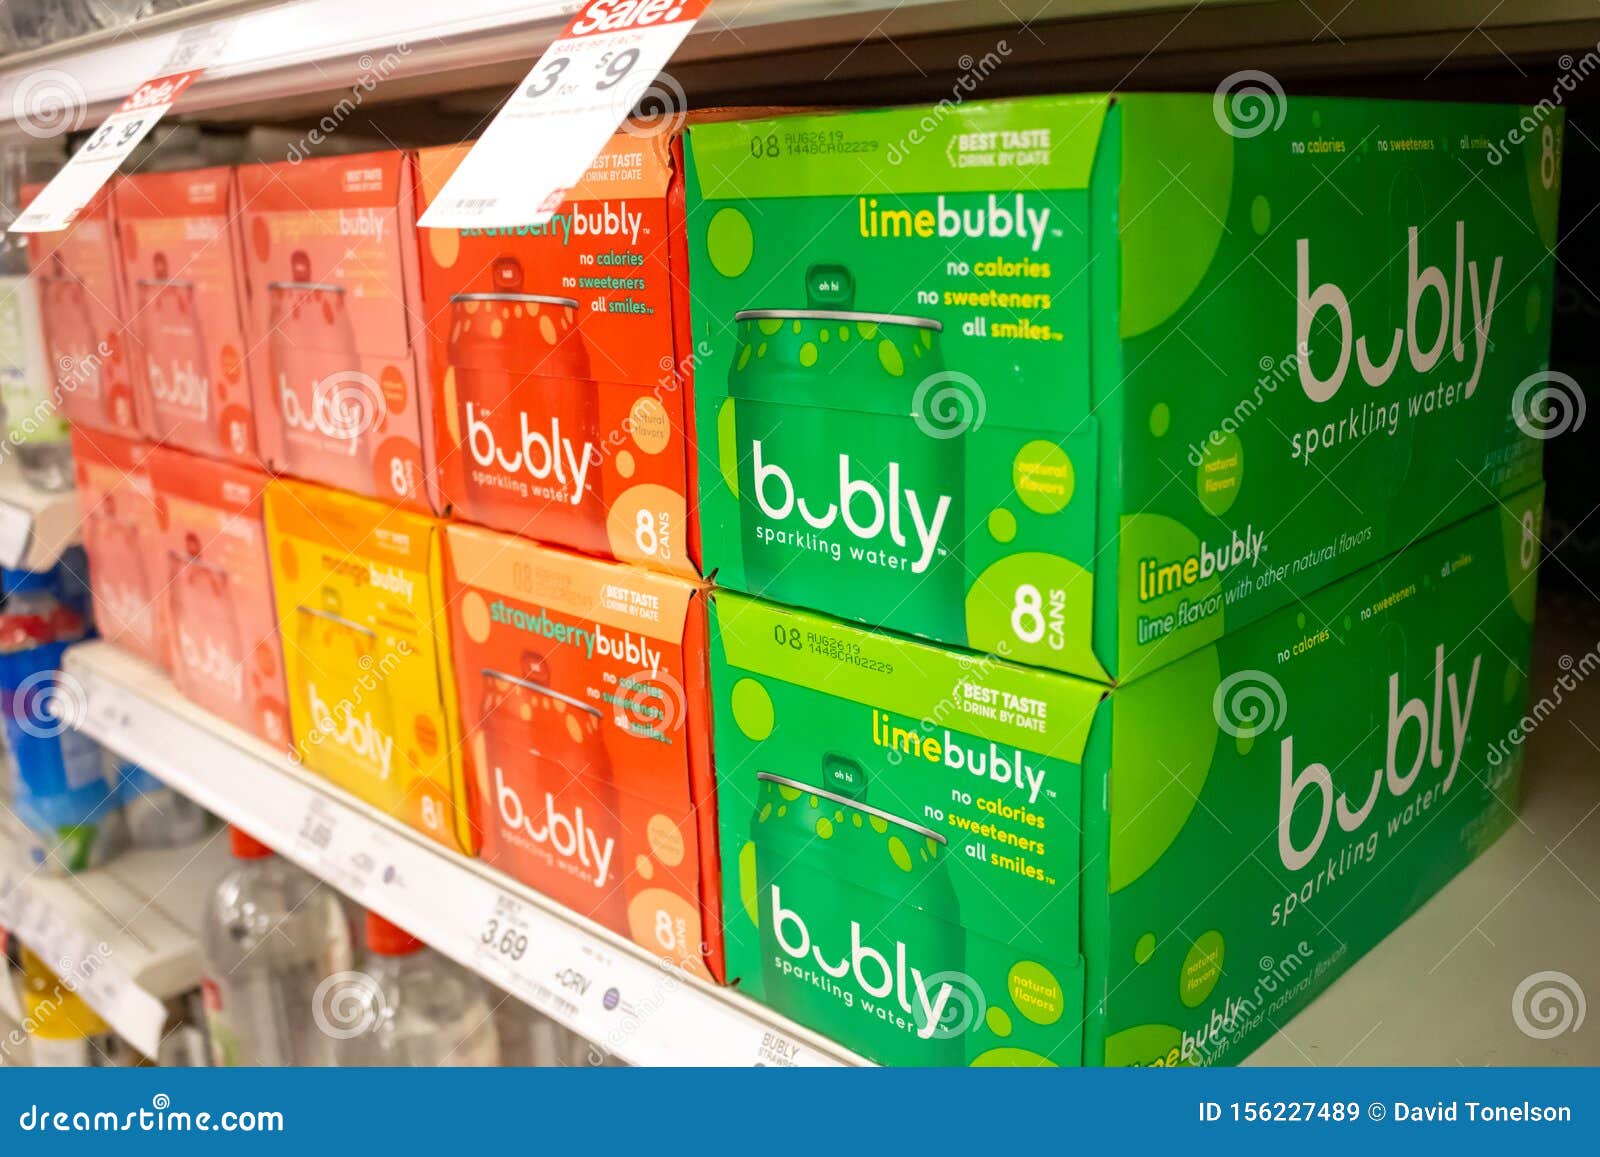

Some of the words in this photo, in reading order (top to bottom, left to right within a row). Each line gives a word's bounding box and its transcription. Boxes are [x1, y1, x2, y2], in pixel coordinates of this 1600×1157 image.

[572, 0, 687, 34] Sale!
[526, 57, 571, 98] 3
[751, 135, 780, 159] 08
[959, 132, 997, 150] BEST
[1002, 129, 1050, 150] TASTE
[1291, 140, 1305, 154] no
[1307, 136, 1345, 153] calories
[1377, 139, 1388, 152] no
[1390, 138, 1434, 151] sweeteners
[612, 152, 642, 168] TASTE
[621, 168, 642, 181] DATE
[958, 154, 995, 168] DRINK
[998, 153, 1013, 167] BY
[1016, 151, 1050, 166] DATE
[859, 194, 1050, 251] limebubly
[580, 253, 594, 265] no
[596, 251, 644, 266] calories
[946, 261, 970, 276] no
[973, 256, 1051, 278] calories
[562, 277, 576, 288] no
[579, 276, 645, 290] sweeteners
[819, 280, 830, 291] oh
[831, 280, 839, 291] hi
[591, 297, 606, 312] all
[609, 299, 647, 314] smiles
[917, 290, 939, 305] no
[943, 290, 1051, 310] sweeteners
[1296, 220, 1503, 403] bubly
[962, 317, 986, 336] all
[990, 319, 1051, 341] smiles
[1291, 401, 1400, 467] sparkling
[1408, 382, 1463, 419] water
[466, 402, 592, 505] bubly
[1018, 461, 1067, 479] natural
[1204, 454, 1238, 473] natural
[391, 456, 407, 496] 8
[472, 470, 528, 497] sparkling
[532, 485, 568, 503] water
[1019, 476, 1065, 496] flavors
[1205, 476, 1236, 493] flavors
[753, 439, 951, 573] bubly
[635, 508, 658, 555] 8
[658, 511, 671, 560] CANS
[756, 525, 840, 560] sparkling
[849, 546, 908, 571] water
[1520, 509, 1534, 571] 8
[1140, 523, 1264, 601] limebubly
[1441, 561, 1451, 578] all
[630, 590, 659, 610] TASTE
[1138, 617, 1173, 644] lime
[1178, 595, 1222, 627] flavor
[1225, 580, 1252, 605] with
[1256, 563, 1290, 590] other
[1292, 537, 1337, 575] natural
[1338, 525, 1373, 554] flavors
[640, 607, 659, 622] DATE
[1010, 583, 1046, 643] 8
[1360, 608, 1372, 621] no
[1373, 584, 1417, 615] sweeteners
[1048, 589, 1066, 650] CANS
[490, 600, 660, 679] strawberrybubly
[774, 624, 803, 650] 08
[1277, 649, 1290, 665] no
[1293, 629, 1330, 657] calories
[586, 685, 600, 699] no
[603, 672, 617, 684] no
[963, 682, 999, 705] BEST
[1001, 691, 1048, 718] TASTE
[963, 702, 998, 722] DRINK
[1000, 708, 1014, 724] BY
[1015, 713, 1047, 733] DATE
[872, 709, 1046, 804] limebubly
[1278, 643, 1481, 871] bubly
[834, 769, 845, 781] oh
[845, 772, 853, 784] hi
[952, 788, 971, 806] no
[976, 796, 1046, 829] calories
[495, 767, 614, 888] bubly
[924, 805, 944, 822] no
[948, 814, 1045, 855] sweeteners
[965, 843, 986, 862] all
[991, 851, 1045, 881] smiles
[1270, 830, 1379, 927] sparkling
[1387, 785, 1444, 839] water
[481, 918, 529, 961] 3.69
[655, 909, 675, 950] 8
[771, 884, 953, 1040] bubly
[1187, 950, 1218, 975] natural
[774, 956, 853, 1007] sparkling
[861, 998, 914, 1034] water
[1013, 974, 1057, 999] natural
[1187, 968, 1216, 990] flavors
[1014, 988, 1055, 1012] flavors
[1233, 1009, 1266, 1045] other
[1268, 973, 1312, 1016] natural
[761, 1032, 801, 1060] BUBLY
